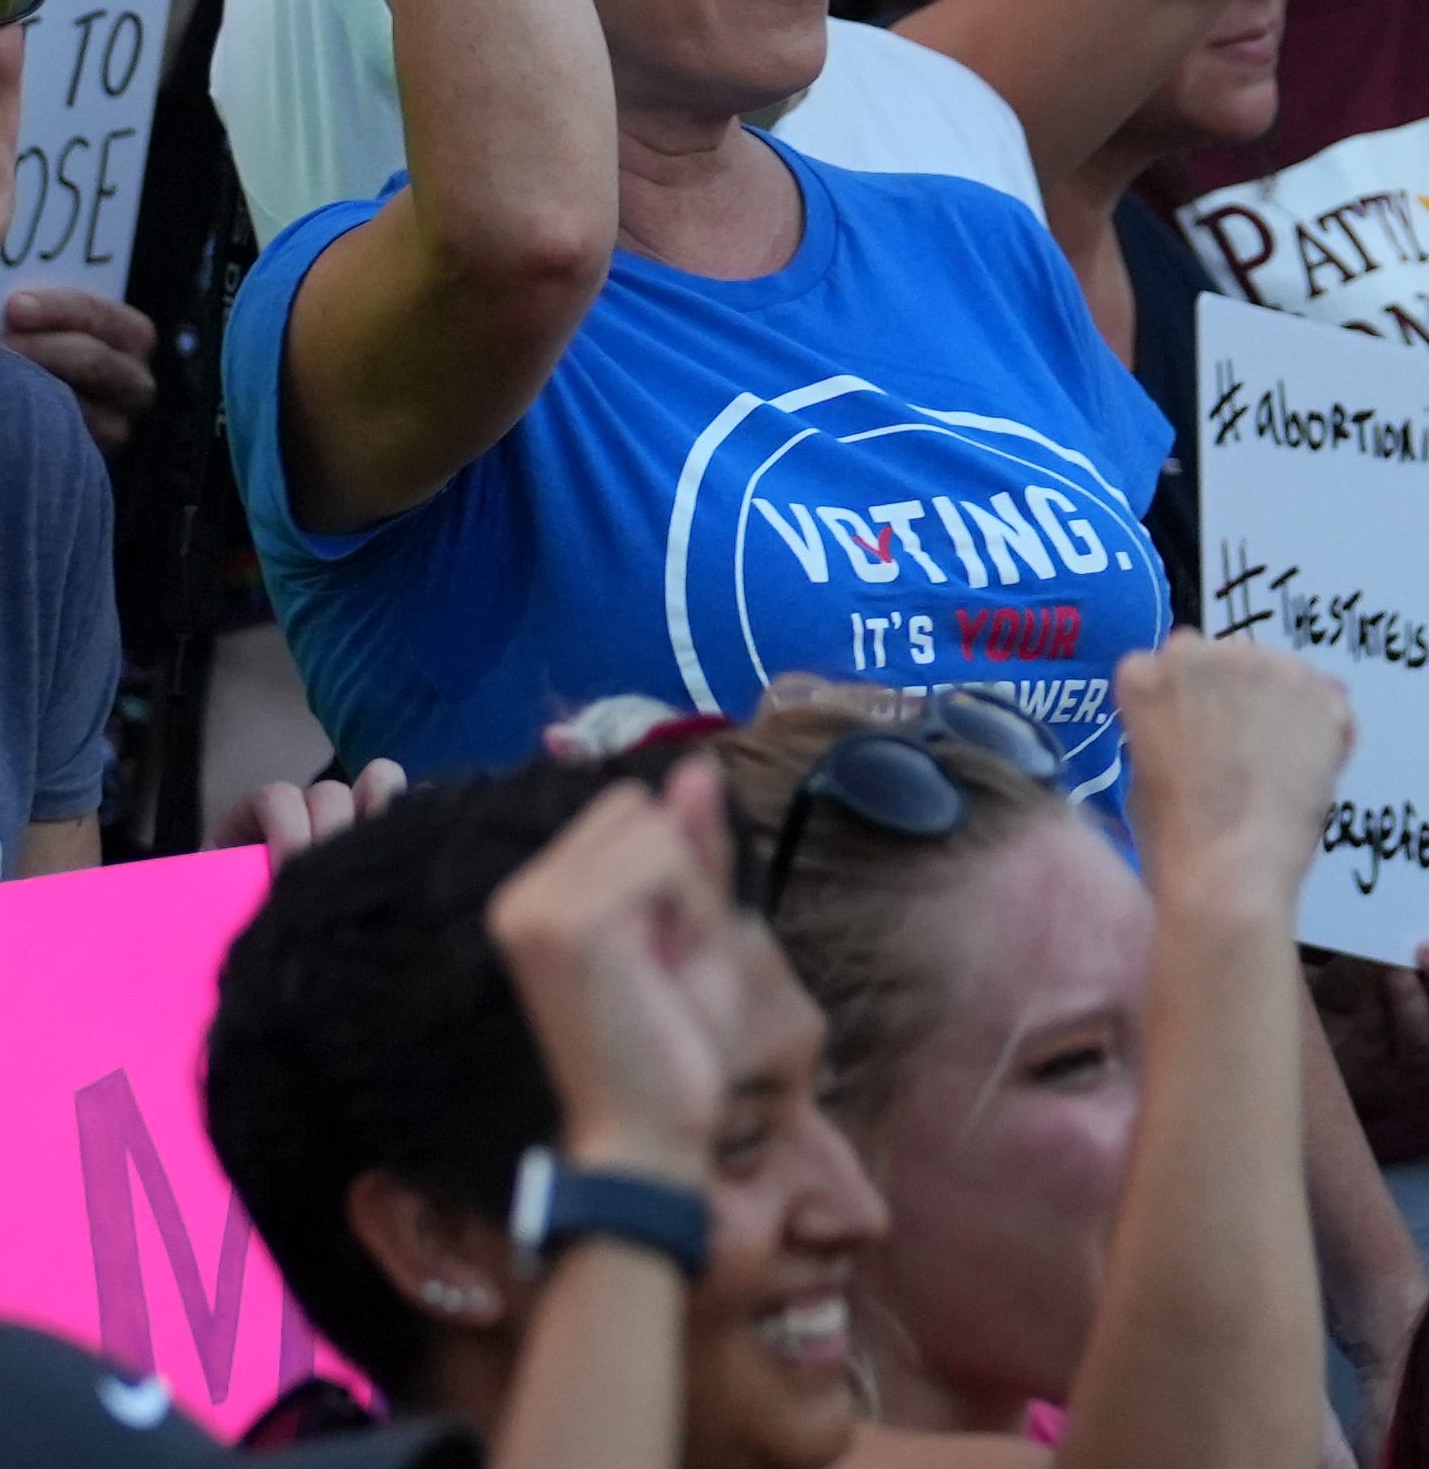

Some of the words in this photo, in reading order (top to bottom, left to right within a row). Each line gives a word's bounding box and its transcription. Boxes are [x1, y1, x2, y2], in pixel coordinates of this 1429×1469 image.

[67, 9, 144, 107] TO
[752, 484, 1133, 588] VOTING.
[850, 612, 935, 670] IT'S
[955, 605, 1081, 662] YOUR
